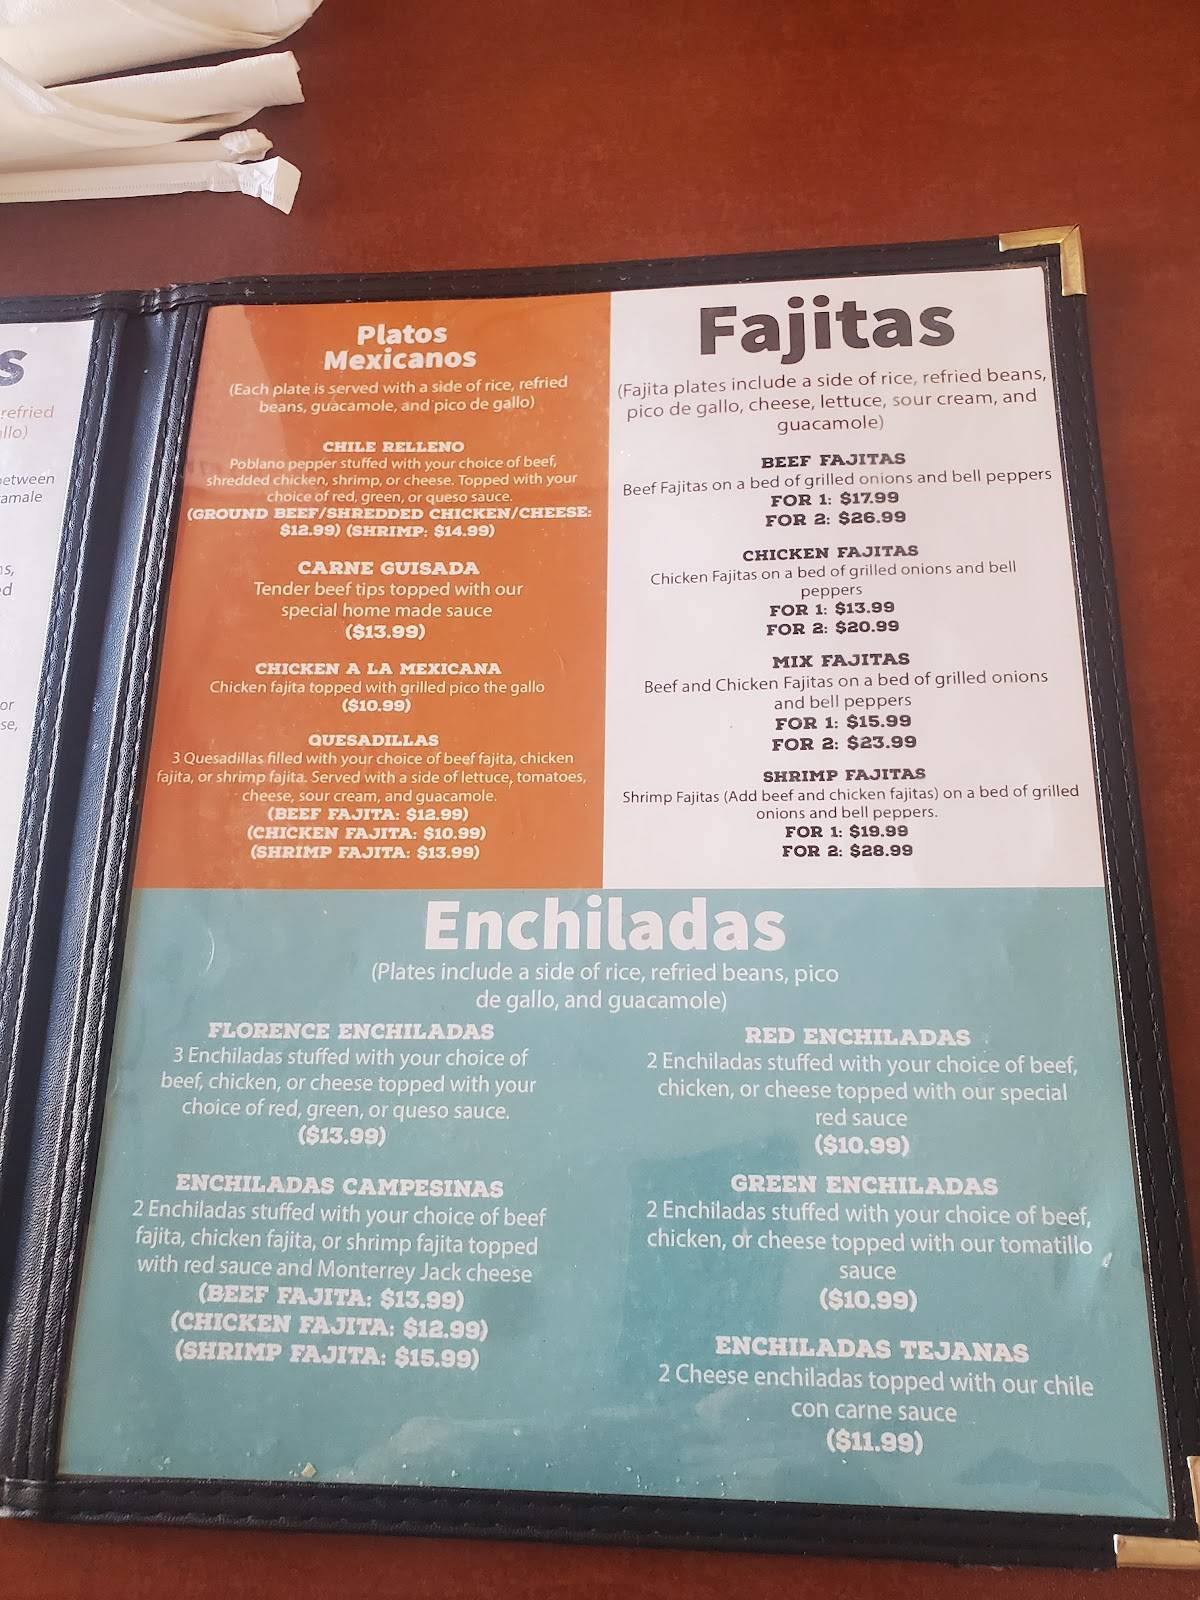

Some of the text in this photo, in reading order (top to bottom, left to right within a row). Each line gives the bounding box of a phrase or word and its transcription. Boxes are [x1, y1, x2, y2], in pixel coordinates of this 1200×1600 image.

[357, 323, 447, 345] Platos
[700, 294, 954, 365] Fajitas
[323, 346, 476, 370] Mexicanos
[229, 375, 568, 398] (Each plate is served with a side of rice, refried
[617, 366, 1047, 400] (Fajita plates include a side of rice, refried beans,
[1, 405, 54, 419] refried
[0, 425, 28, 440] llo)
[322, 441, 464, 452] CHILE RELLENO
[761, 452, 906, 469] BEEF FAJITAS
[0, 474, 55, 486] etween
[0, 491, 42, 504] amale
[770, 491, 899, 507] FOR 1: $17.99
[187, 506, 592, 521] (GROUND BEEF/SHREDDED CHICKEN/CHEESE:
[765, 510, 906, 527] FOR 2: $26.99
[279, 522, 495, 538] $12.99) (SHRIMP: $14.99)
[742, 544, 919, 562] CHICKEN FAJITAS
[297, 560, 480, 575] CARNE GUISADA
[253, 580, 523, 599] Tender beef tips topped with our
[769, 601, 895, 617] FOR 1: $13.99
[345, 623, 425, 640] ($13.99)
[766, 620, 899, 636] FOR 2: $20.99
[255, 662, 502, 675] CHICKEN A LA MEXICANA
[772, 652, 910, 669] MIX FAJITAS
[209, 680, 545, 697] Chicken fajita topped with grilled pico the gallo
[342, 698, 411, 713] ($10.99)
[775, 713, 911, 730] FOR 1: $15.99
[308, 734, 439, 746] QUESADILLAS
[771, 734, 917, 751] FOR 2: $23.99
[763, 767, 926, 783] SHRIMP FAJITAS
[267, 806, 468, 822] (BEEF FAJITA: $12.99)
[756, 805, 938, 821] onions and bell peppers.
[247, 824, 486, 841] (CHICKEN FAJITA: $10.99)
[785, 824, 908, 839] FOR 1: $19.99
[250, 844, 480, 860] (SHRIMP FAJITA: $13.99)
[782, 843, 913, 858] FOR 2: $28.99
[424, 894, 786, 952] Enchiladas
[371, 961, 839, 987] (Plates include a side of rice, refried beans, pico
[208, 1021, 494, 1040] FLORENCE ENCHILADAS
[744, 1026, 971, 1046] RED ENCHILADAS
[815, 1107, 907, 1127] red sauce
[298, 1124, 386, 1147] ($13.99)
[814, 1133, 910, 1157] ($10.99)
[175, 1173, 503, 1198] ENCHILADAS CAMPESINAS
[731, 1174, 998, 1195] GREEN ENCHILADAS
[137, 1254, 532, 1285] with red sauce and Monterrey Jack cheese
[839, 1265, 896, 1280] sauce
[198, 1281, 464, 1312] (BEEF FAJITA: $13.99)
[819, 1287, 917, 1313] ($10.99)
[171, 1309, 488, 1342] (CHICKEN FAJITA: $12.99)
[175, 1338, 479, 1371] (SHRIMP FAJITA: $15.99)
[715, 1335, 1029, 1363] ENCHILADAS TEJANAS
[791, 1401, 957, 1423] con carne sauce
[826, 1427, 923, 1456] ($11.99)
